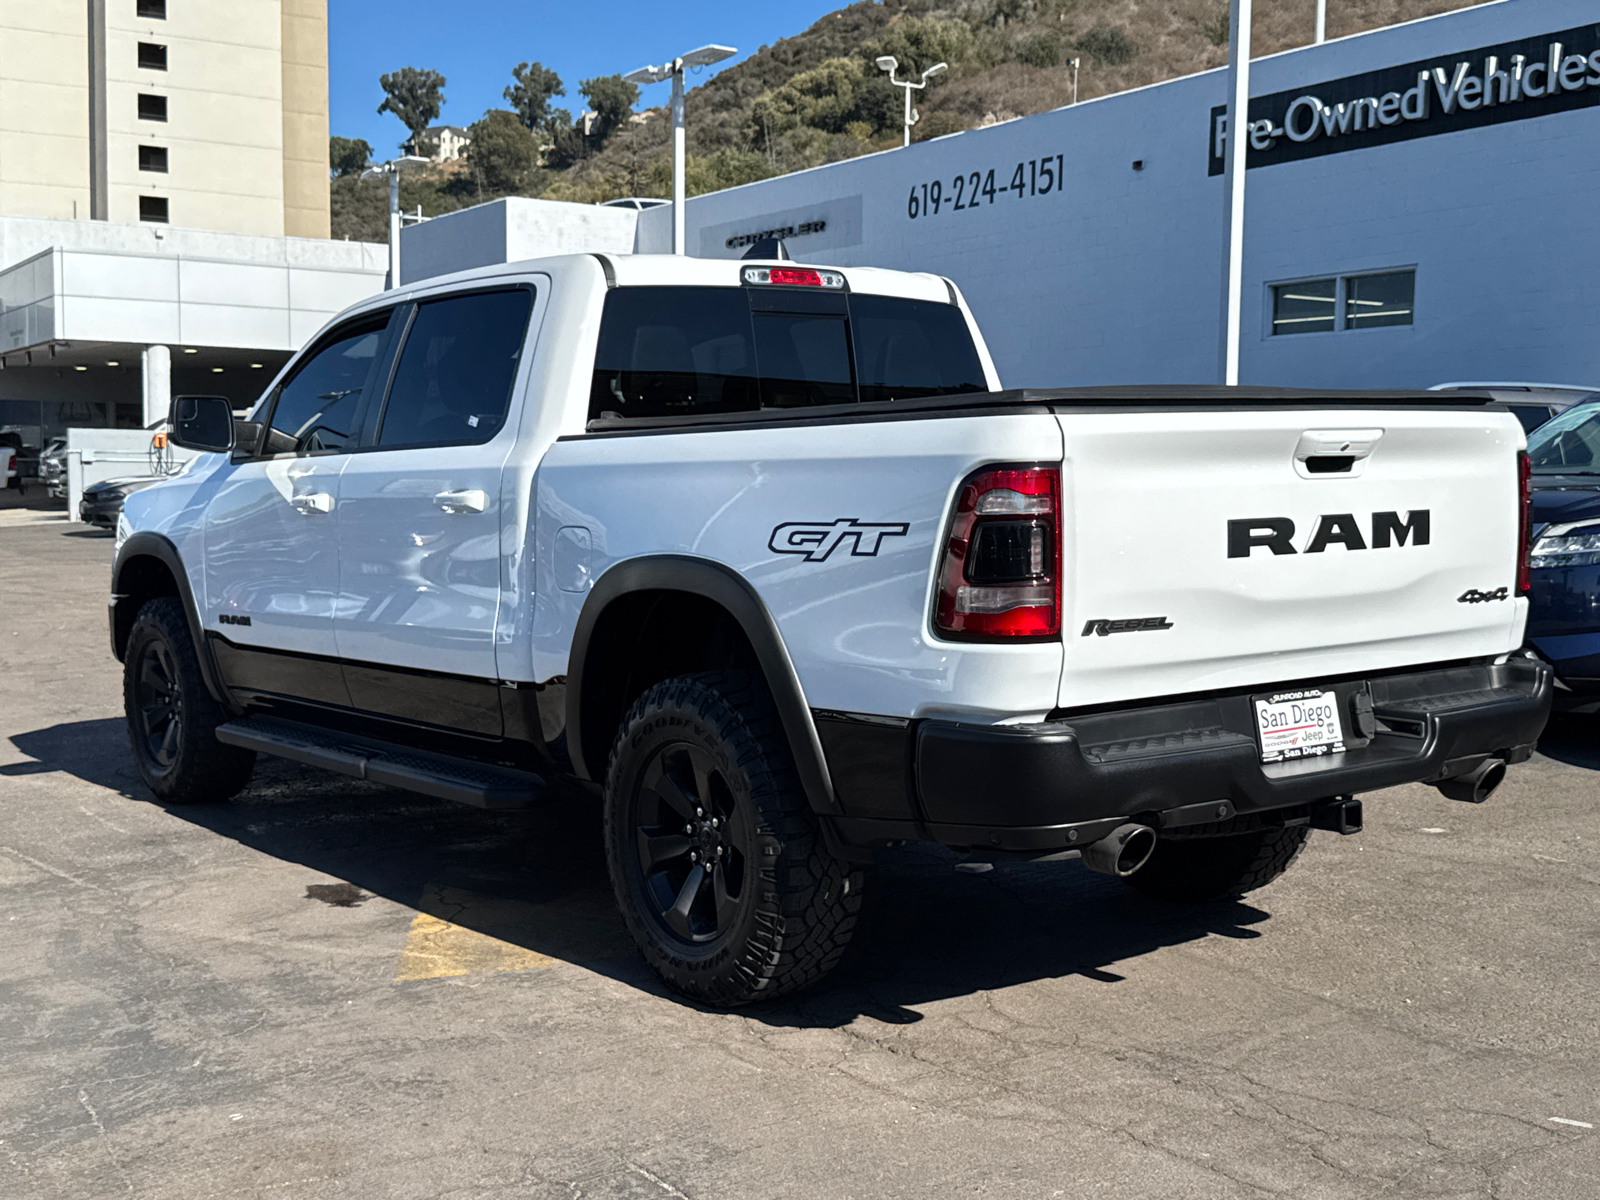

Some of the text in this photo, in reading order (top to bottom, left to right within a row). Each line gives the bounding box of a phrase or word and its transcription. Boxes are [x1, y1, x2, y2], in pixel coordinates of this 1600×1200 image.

[1215, 42, 1600, 158] Pe-Owned Vehicles
[907, 154, 1064, 219] 619-224-4151
[725, 220, 826, 249] CHRYSLER
[1227, 509, 1430, 558] RAM
[219, 614, 251, 626] RAM
[1081, 616, 1174, 636] REBEL
[1260, 702, 1332, 729] San Diego
[1302, 730, 1323, 742] Jeep
[1284, 749, 1301, 758] San
[1302, 745, 1327, 755] Diego
